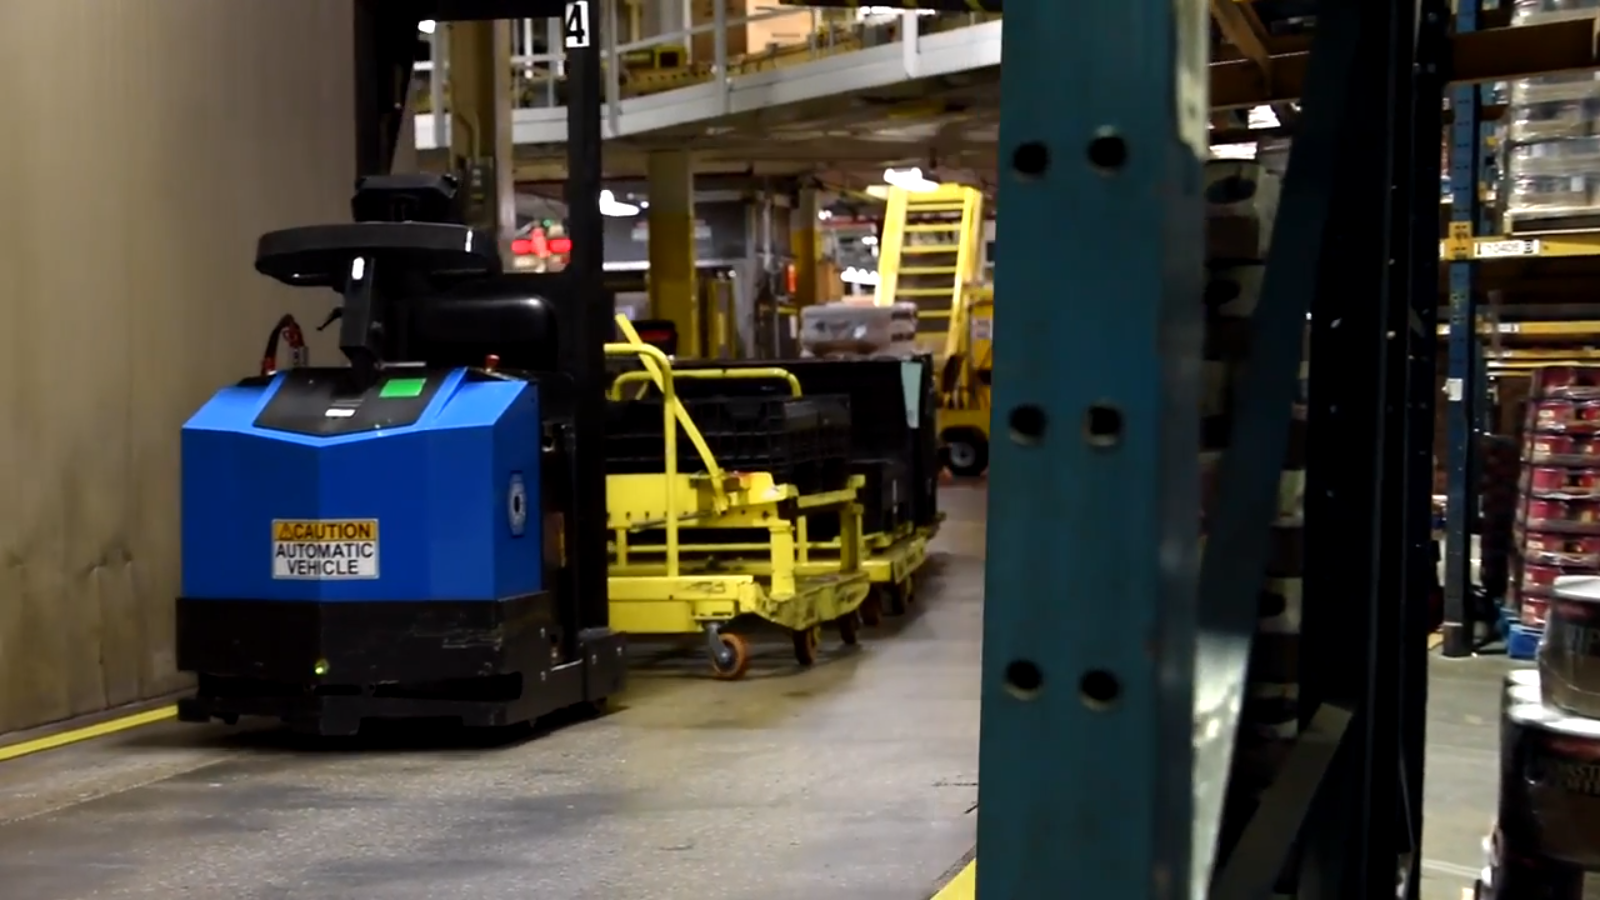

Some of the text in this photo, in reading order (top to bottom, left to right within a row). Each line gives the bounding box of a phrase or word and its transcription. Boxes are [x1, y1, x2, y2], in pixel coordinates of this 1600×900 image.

[566, 4, 585, 44] 4
[293, 523, 370, 539] CAUTION
[276, 543, 373, 558] AUTOMATIC
[287, 559, 358, 575] VEHICLE
